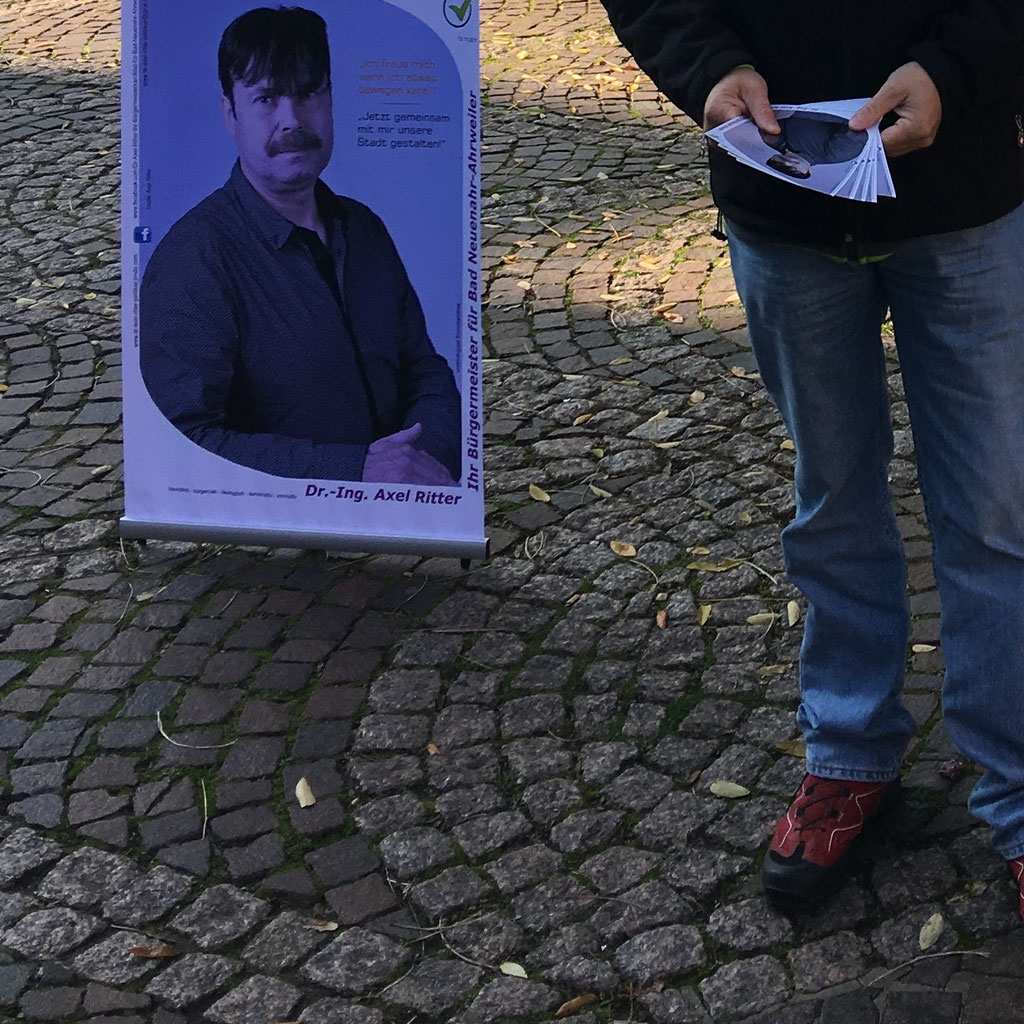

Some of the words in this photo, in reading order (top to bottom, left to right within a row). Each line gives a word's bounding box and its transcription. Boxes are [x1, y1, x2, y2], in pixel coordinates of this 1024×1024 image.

[357, 125, 374, 134] mit
[377, 126, 394, 134] mir
[397, 127, 433, 135] unsere
[394, 113, 450, 123] gemeinsam
[357, 137, 387, 147] Stadt
[467, 89, 479, 265] Neuenahr-Ahrweiler
[468, 268, 478, 303] Bad
[468, 306, 479, 333] für
[467, 336, 480, 460] Bürgermeister
[467, 463, 480, 493] Ihr
[304, 484, 368, 503] Dr.-Ing.
[373, 488, 411, 502] Axel
[415, 491, 462, 505] Ritter
